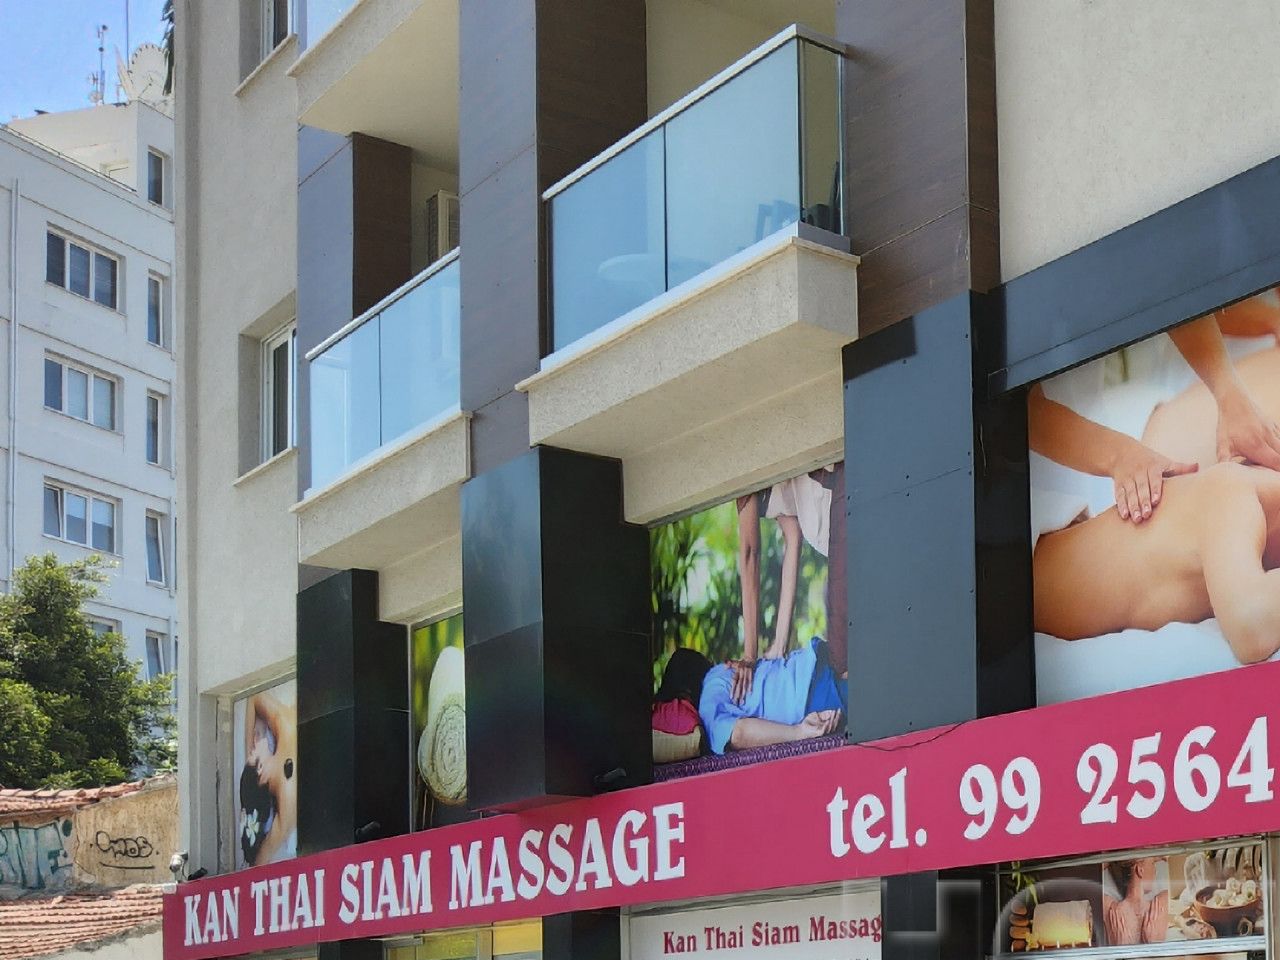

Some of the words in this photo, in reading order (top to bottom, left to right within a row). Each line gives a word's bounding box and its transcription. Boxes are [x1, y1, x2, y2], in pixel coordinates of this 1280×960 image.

[184, 886, 240, 946] KAN
[251, 869, 325, 936] THAI
[338, 850, 433, 924] SIAM
[449, 802, 684, 910] MASSAGE
[826, 767, 927, 857] tel.
[959, 756, 1041, 840] 99
[663, 931, 697, 953] Kan
[704, 925, 743, 950] Thai
[752, 921, 800, 946] Siam
